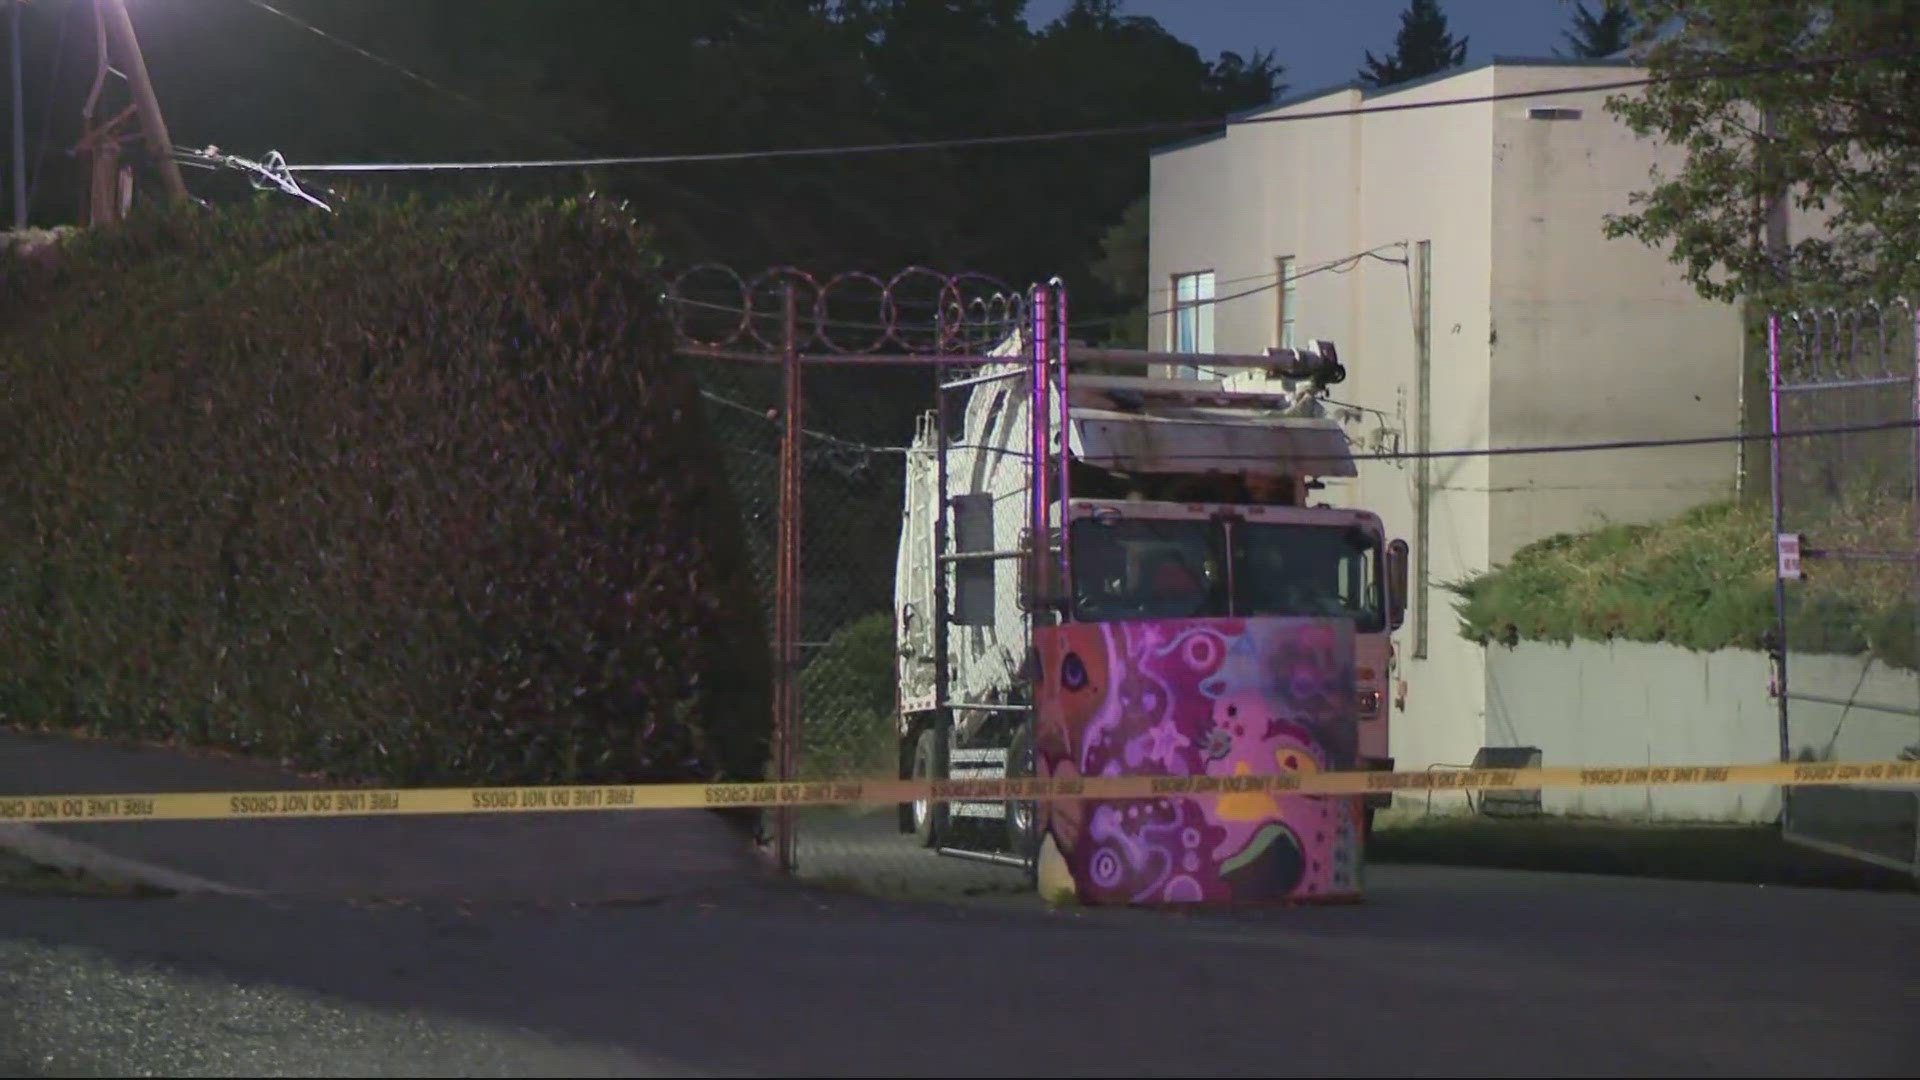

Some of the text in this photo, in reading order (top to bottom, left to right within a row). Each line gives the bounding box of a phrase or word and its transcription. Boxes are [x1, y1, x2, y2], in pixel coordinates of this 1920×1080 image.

[1580, 767, 1729, 785] FIRE LINE DO NOT CROSS
[472, 788, 635, 808] FIRE LINE DO NOT CROSS
[705, 784, 862, 803] FIRE LINE DO NOT CROSS
[31, 801, 58, 817] NOT
[63, 800, 83, 816] DO
[88, 800, 119, 816] LINE
[125, 799, 154, 815] FIRE
[230, 793, 399, 813] FIRE LINE DO NOT CROSS
